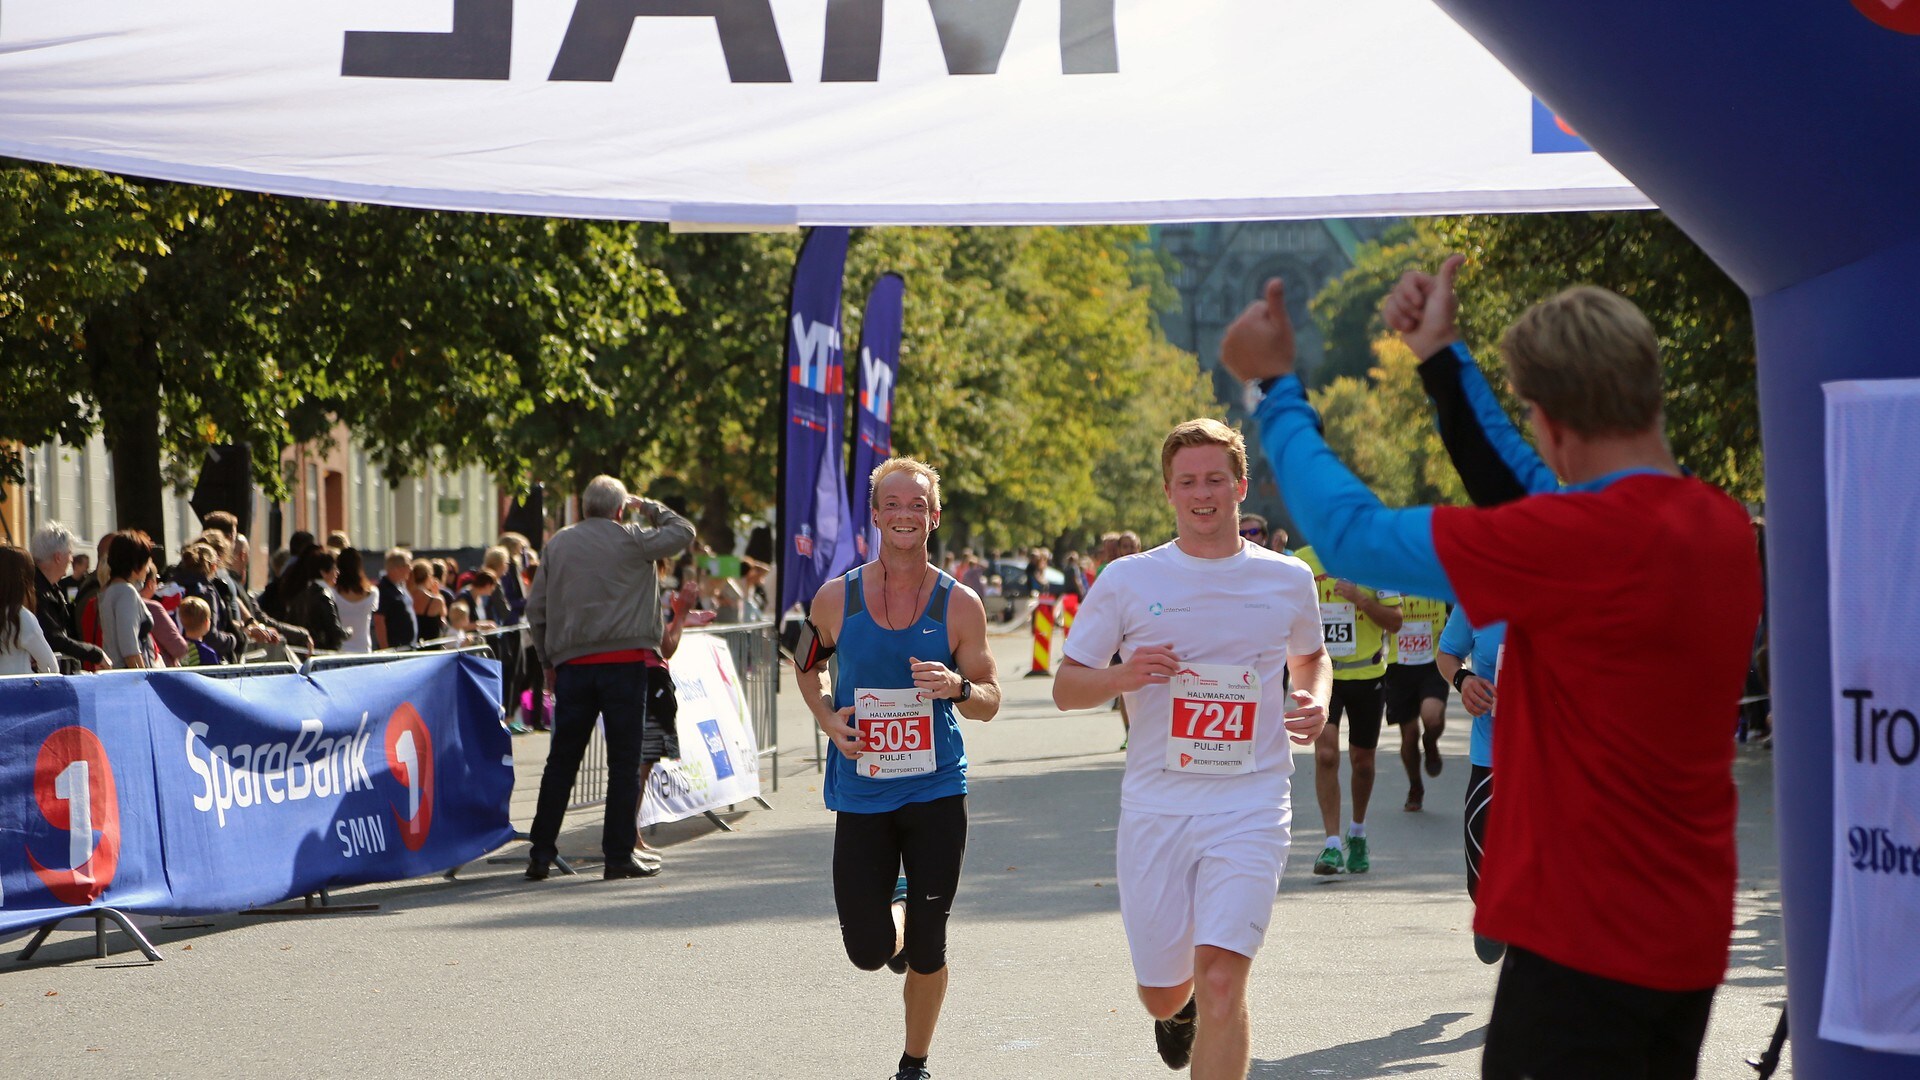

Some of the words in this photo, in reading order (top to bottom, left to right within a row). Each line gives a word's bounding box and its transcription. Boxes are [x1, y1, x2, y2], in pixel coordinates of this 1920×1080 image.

[1399, 635, 1432, 652] 2523
[1187, 691, 1246, 700] HALVMARATON
[869, 710, 920, 718] HALVMARATON
[1184, 702, 1244, 739] 724
[869, 719, 921, 751] 505
[1842, 688, 1920, 766] Tro
[1193, 741, 1224, 751] PULJE
[879, 753, 906, 761] PULJE
[1193, 758, 1243, 766] BEDRIFTSIDRETTEN
[186, 711, 374, 829] SpareBank
[881, 766, 925, 774] BEDRIFTSIDRETTEN
[54, 760, 95, 885] 1
[336, 814, 387, 859] SMN
